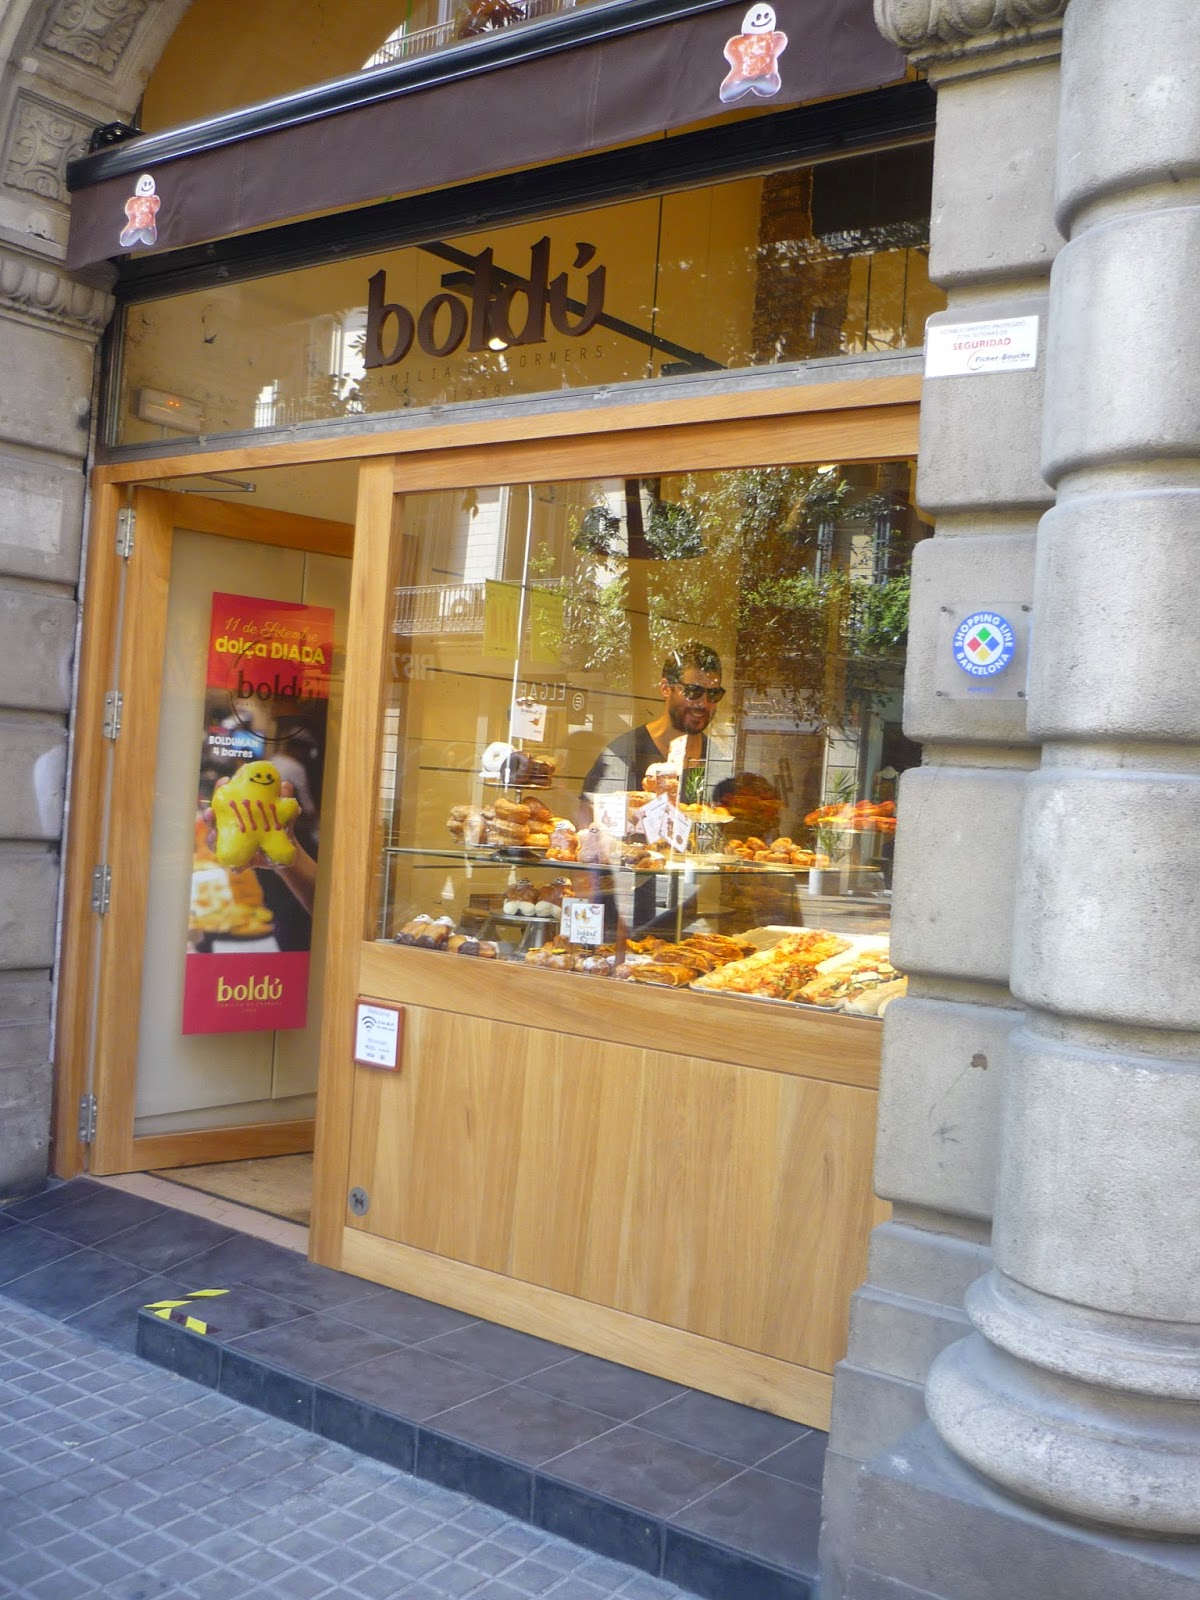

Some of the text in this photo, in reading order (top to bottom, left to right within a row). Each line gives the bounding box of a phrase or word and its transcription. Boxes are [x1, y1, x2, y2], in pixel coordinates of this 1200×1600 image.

[364, 236, 607, 369] boldú
[953, 338, 1012, 351] SEGURIDAD
[225, 617, 241, 632] 11
[242, 620, 258, 635] de
[954, 614, 1014, 648] SHOPPING LINE
[270, 642, 325, 664] DIADA
[956, 653, 1009, 675] BARCELONA
[213, 746, 254, 759] 4 barres
[217, 974, 283, 1002] boldú
